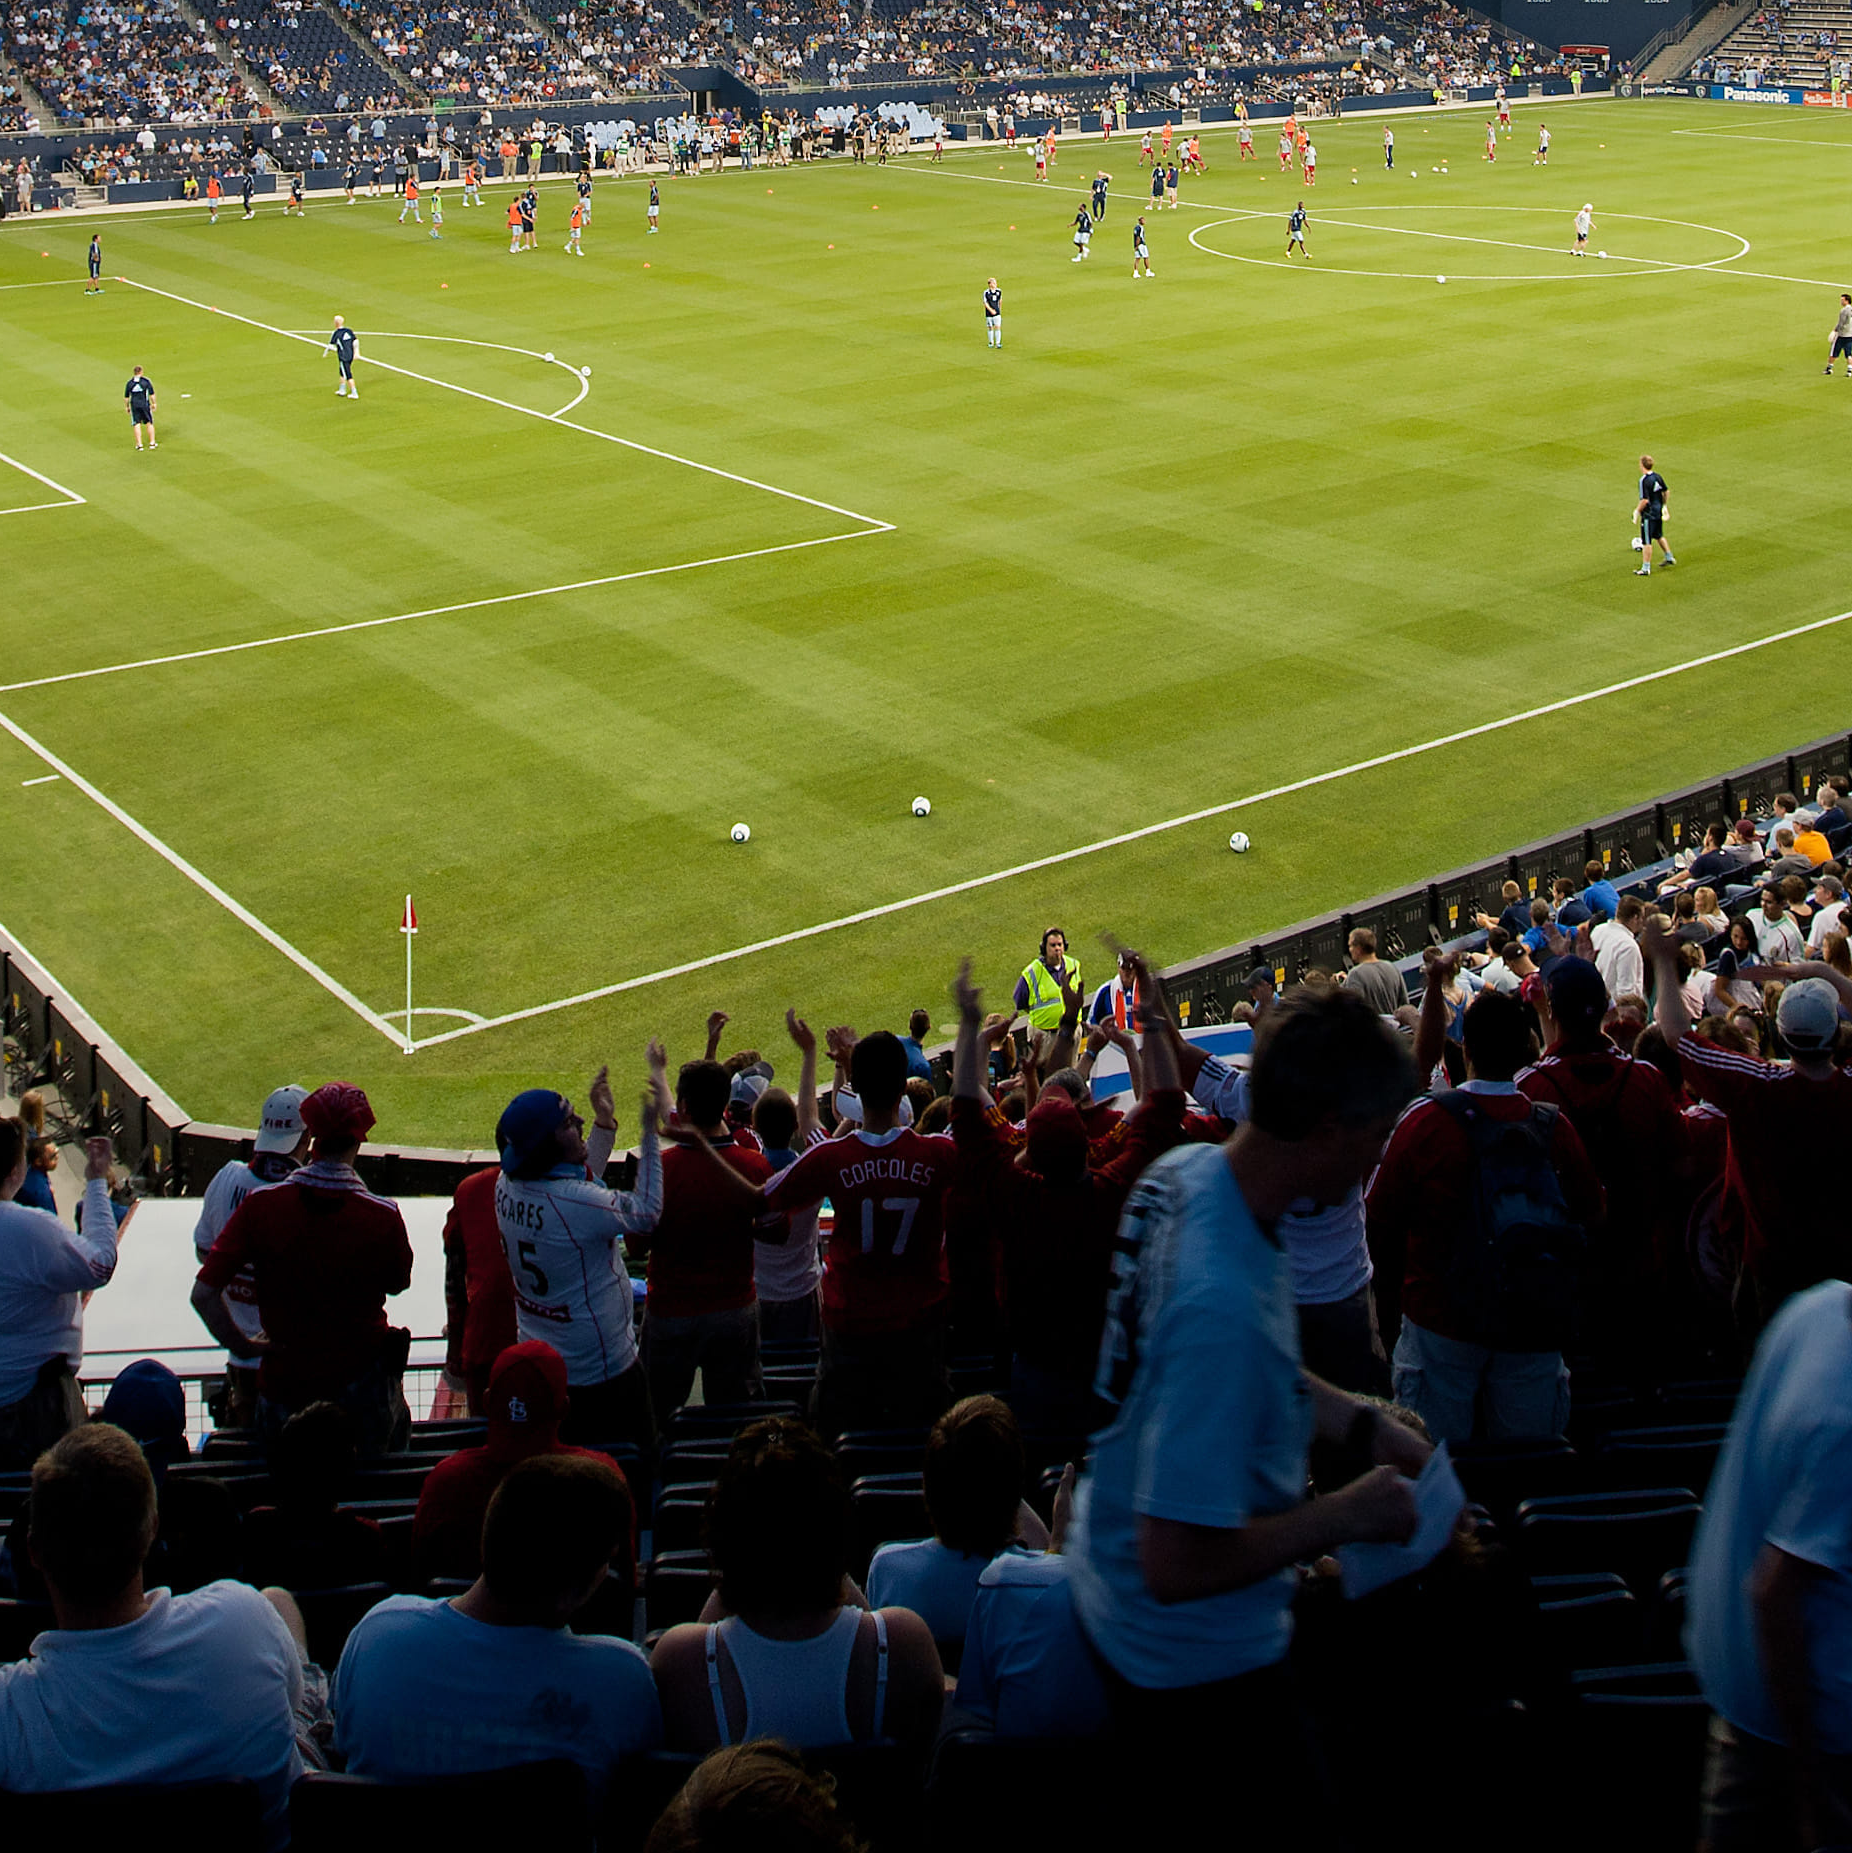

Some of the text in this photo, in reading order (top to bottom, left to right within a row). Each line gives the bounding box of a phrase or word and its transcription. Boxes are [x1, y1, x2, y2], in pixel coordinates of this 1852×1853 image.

[1724, 87, 1790, 104] Panasonic
[264, 1117, 292, 1129] FIRE
[839, 1158, 935, 1188] CORCOLES
[861, 1197, 920, 1255] 17
